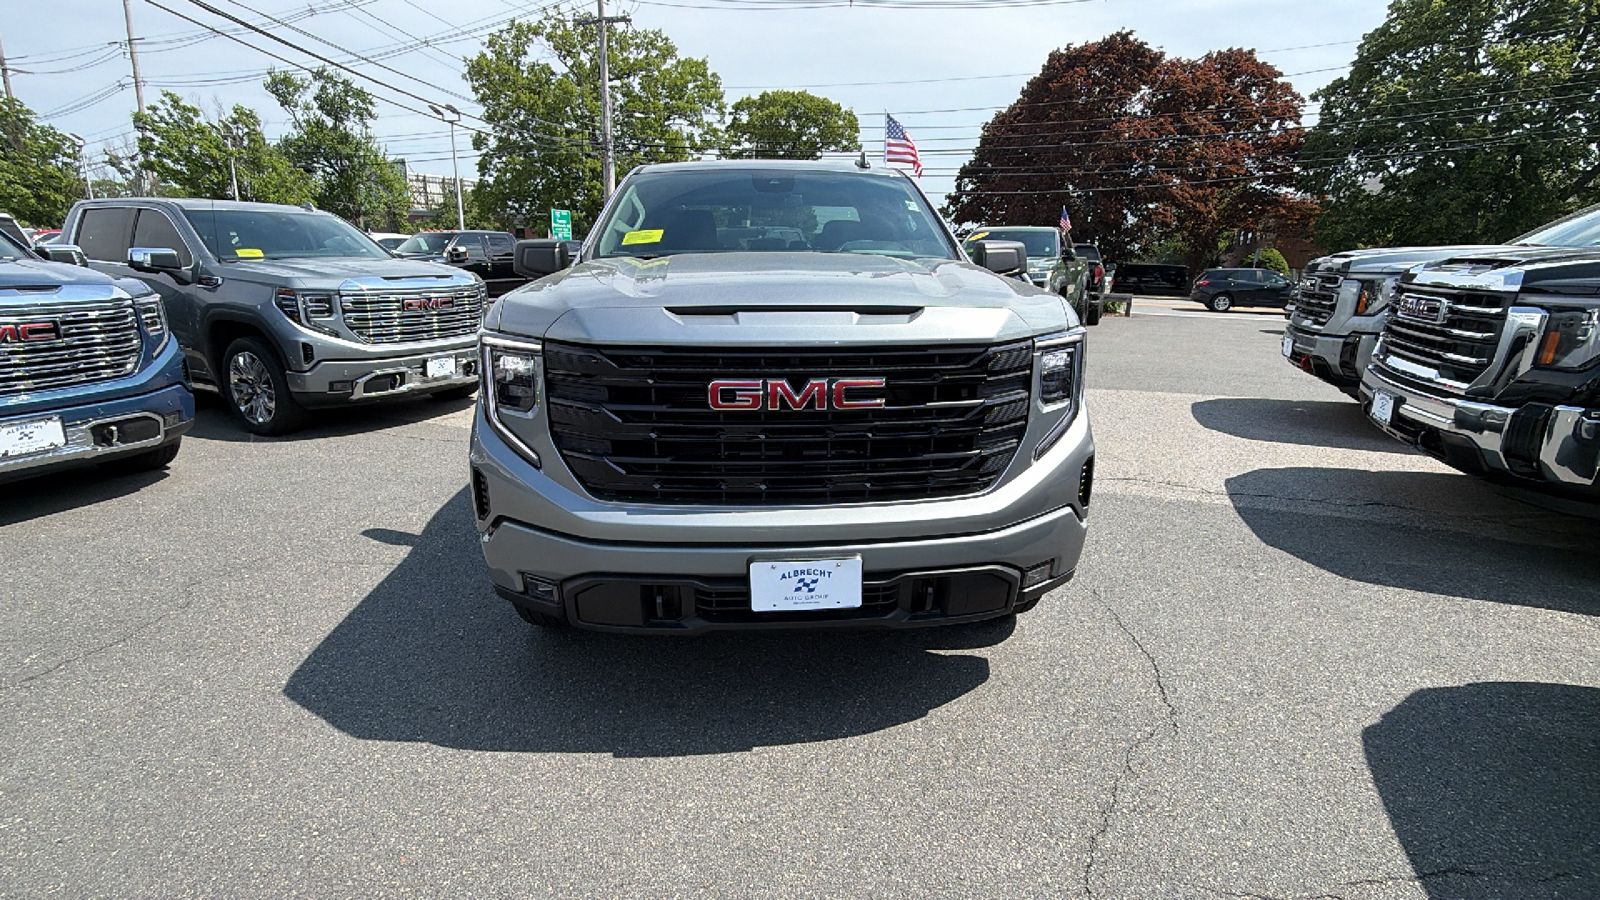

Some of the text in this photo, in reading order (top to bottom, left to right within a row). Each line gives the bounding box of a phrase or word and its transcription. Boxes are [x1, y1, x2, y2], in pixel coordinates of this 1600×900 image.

[403, 297, 453, 311] GMC
[708, 377, 886, 411] GMC
[780, 568, 832, 580] ALBRECHT
